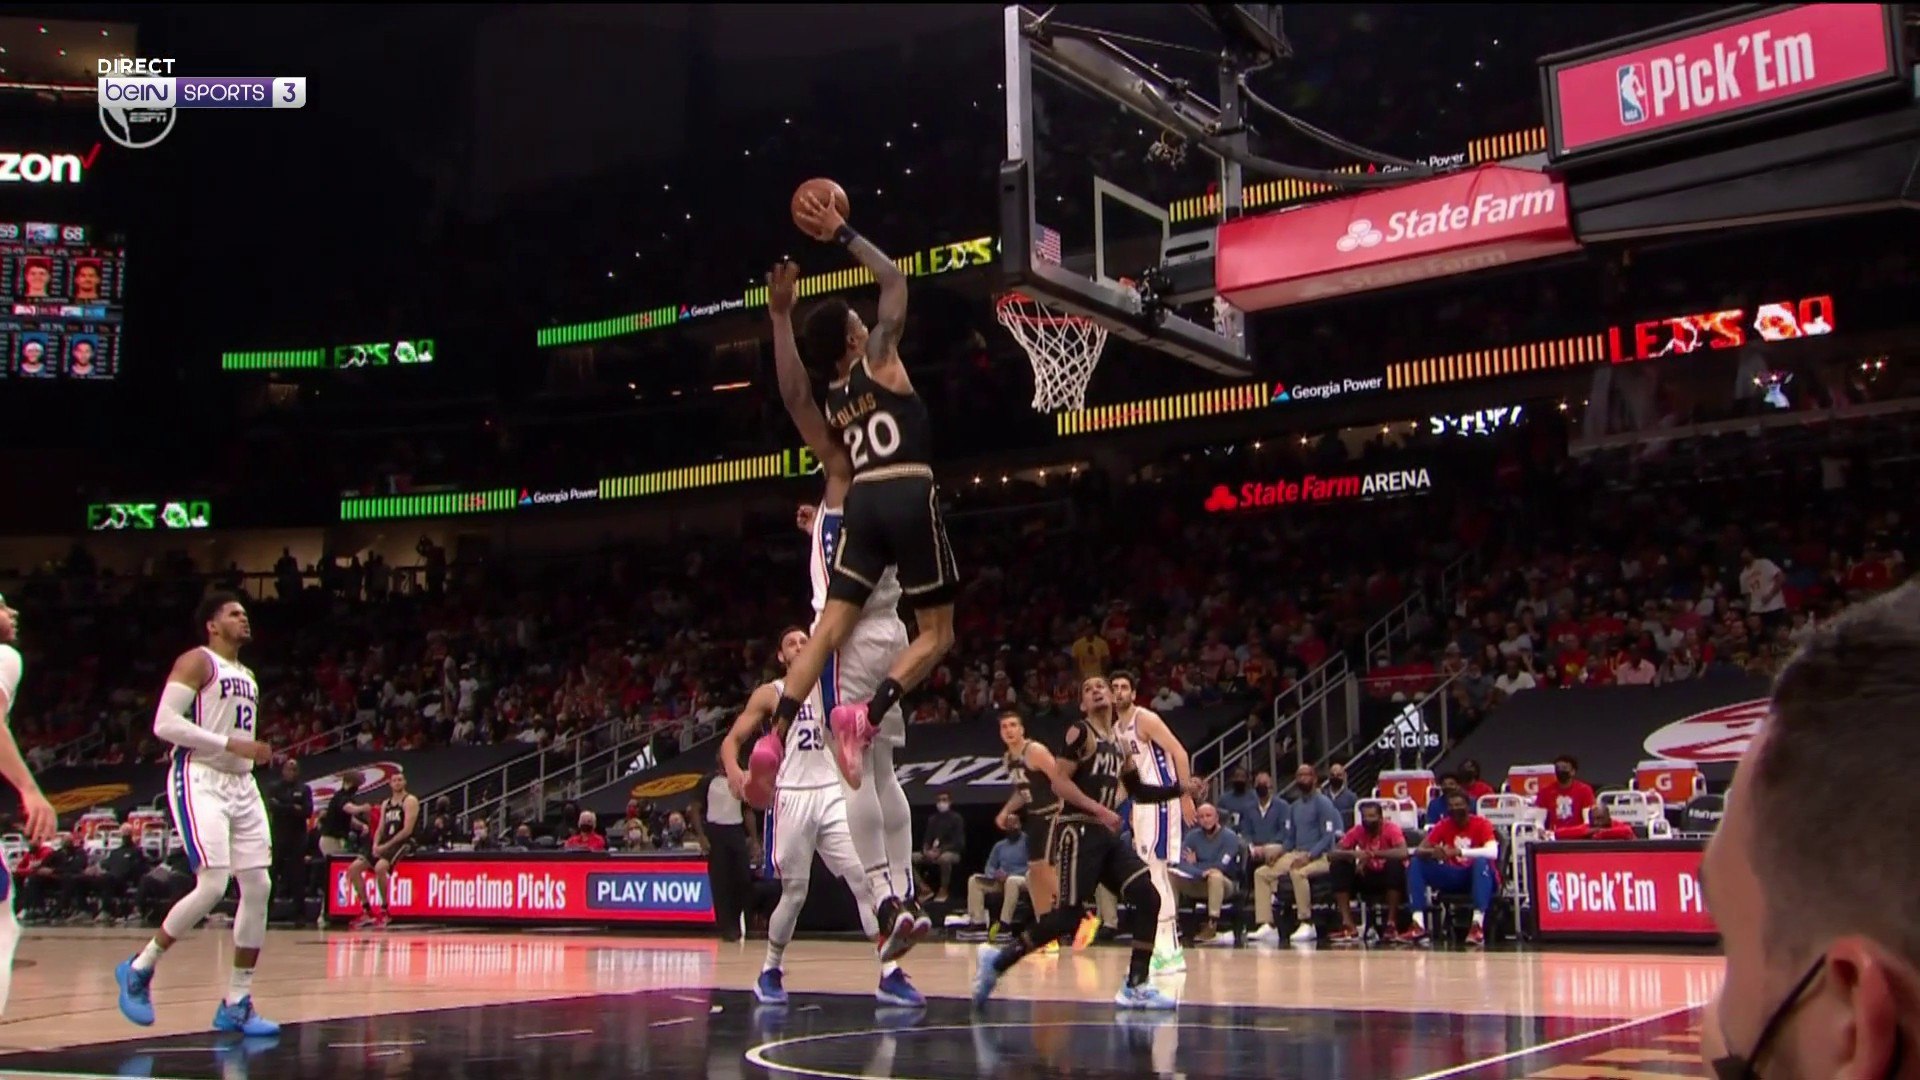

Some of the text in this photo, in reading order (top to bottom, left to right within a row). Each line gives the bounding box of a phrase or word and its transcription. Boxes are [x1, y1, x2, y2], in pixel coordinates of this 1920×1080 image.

[1650, 29, 1815, 117] Pick'Em
[63, 227, 84, 241] 68
[1385, 187, 1556, 243] State Farm
[1609, 309, 1746, 364] LET'S
[1291, 376, 1383, 400] Georgia Power
[843, 410, 901, 469] 20
[1240, 467, 1431, 507] State Farm ARENA
[234, 704, 253, 732] 12
[1394, 781, 1408, 798] G
[1524, 776, 1539, 795] G
[1655, 773, 1673, 791] G
[428, 872, 513, 908] Primetime
[517, 872, 566, 910] Picks
[597, 879, 648, 903] PLAY
[652, 880, 702, 903] NOW
[1565, 872, 1657, 912] Pick'Em
